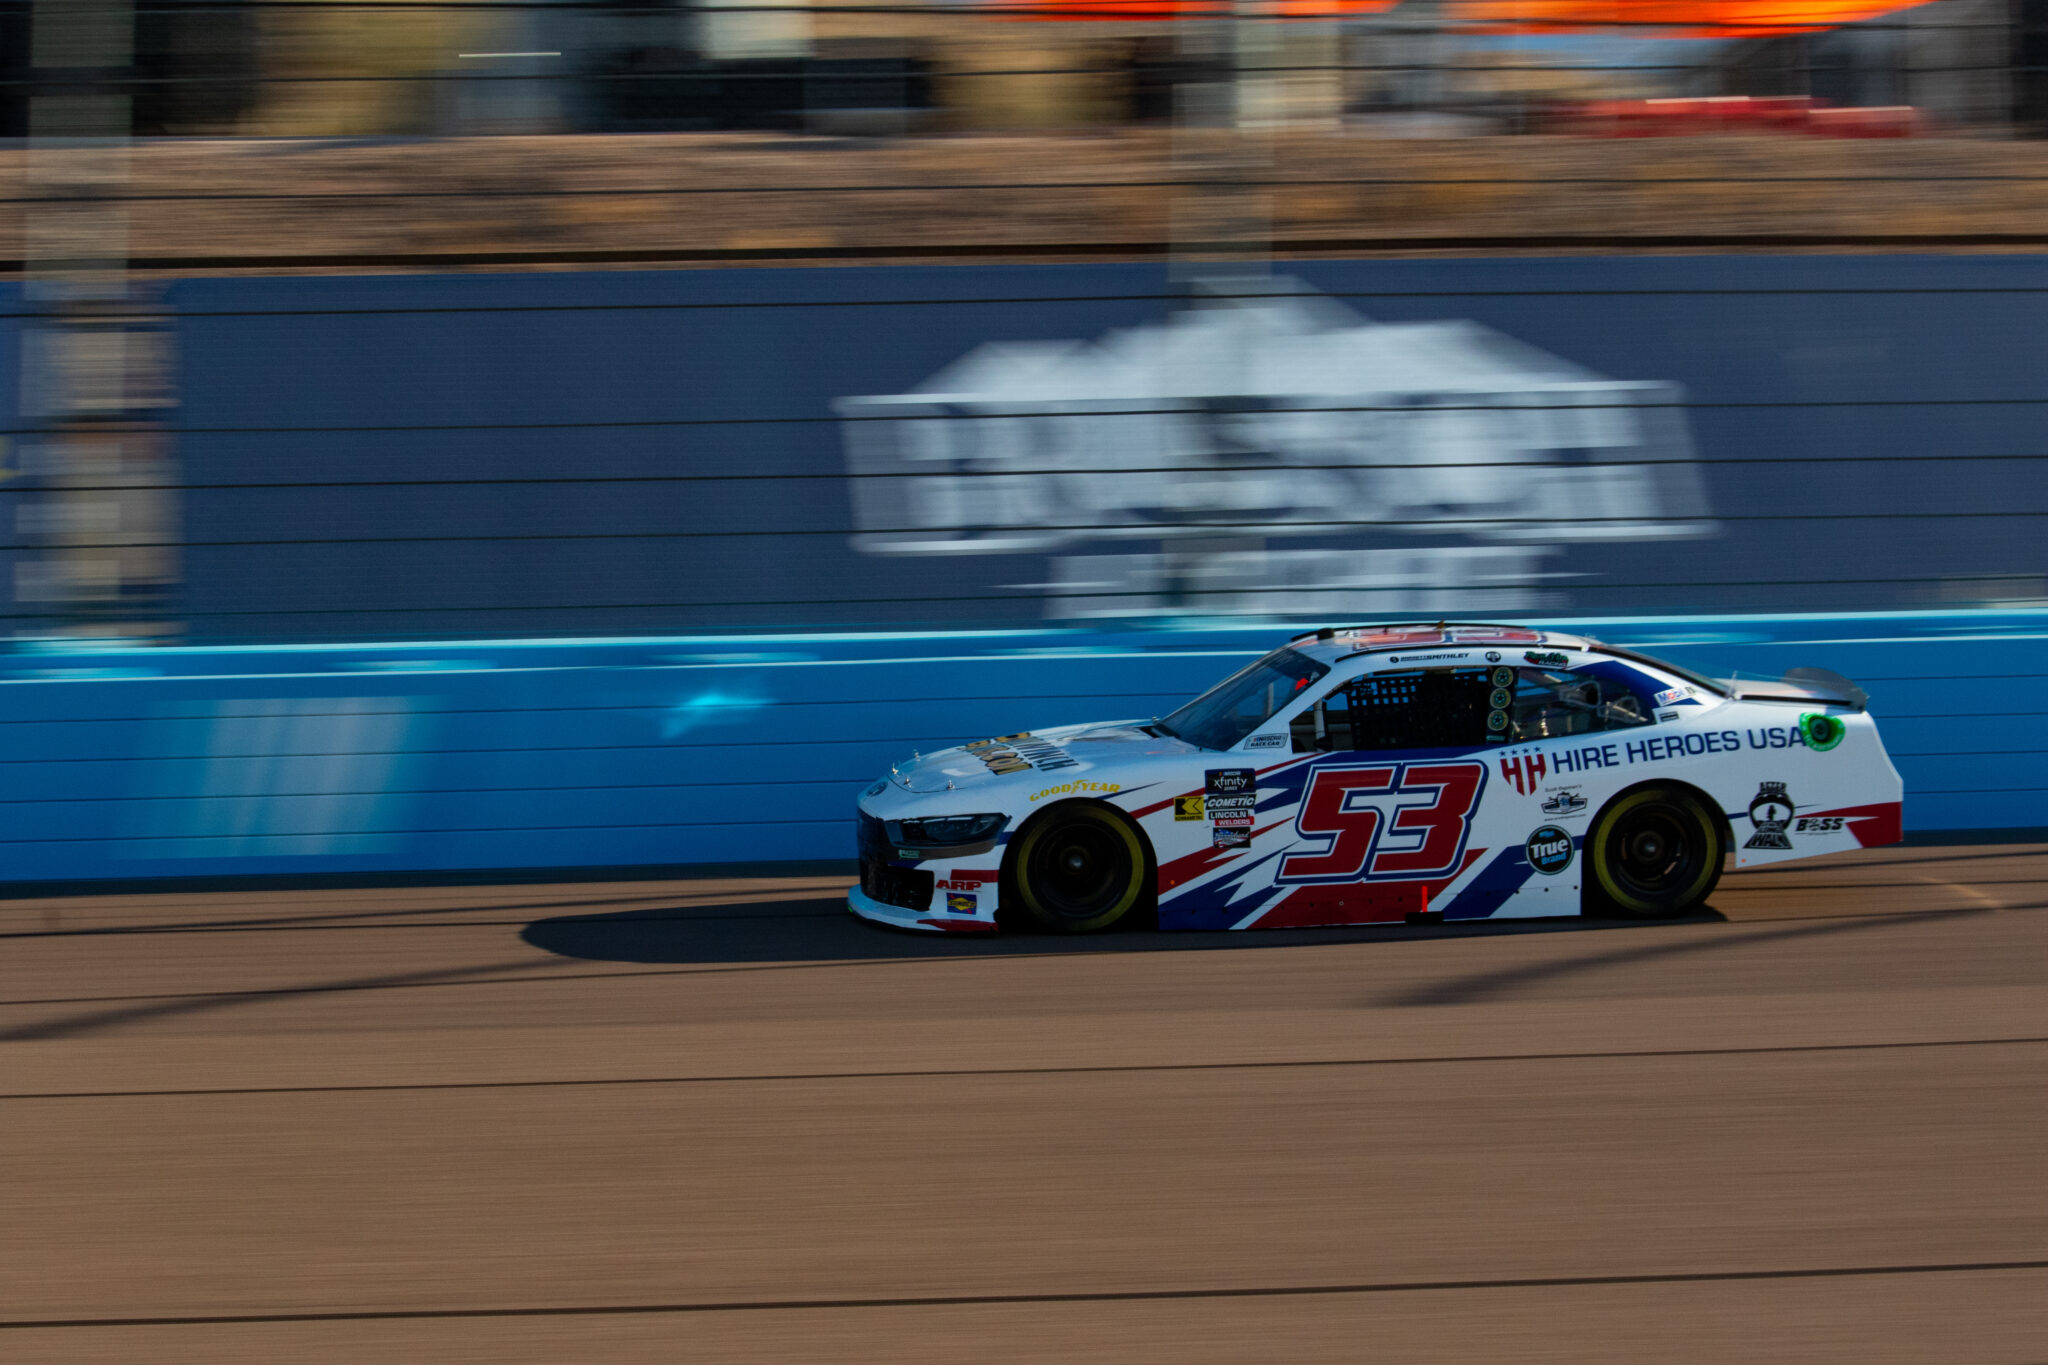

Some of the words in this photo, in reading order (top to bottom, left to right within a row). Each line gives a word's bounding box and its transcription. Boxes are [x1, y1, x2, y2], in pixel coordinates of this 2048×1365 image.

[1552, 744, 1619, 774] HIRE
[1626, 730, 1740, 763] HEROES
[1747, 726, 1807, 750] USA
[1214, 776, 1248, 789] xfinity
[1207, 797, 1255, 808] COMETIC
[1210, 811, 1247, 819] LINCOLN
[1274, 760, 1489, 886] 53
[1530, 838, 1570, 859] True
[935, 879, 982, 891] ARP
